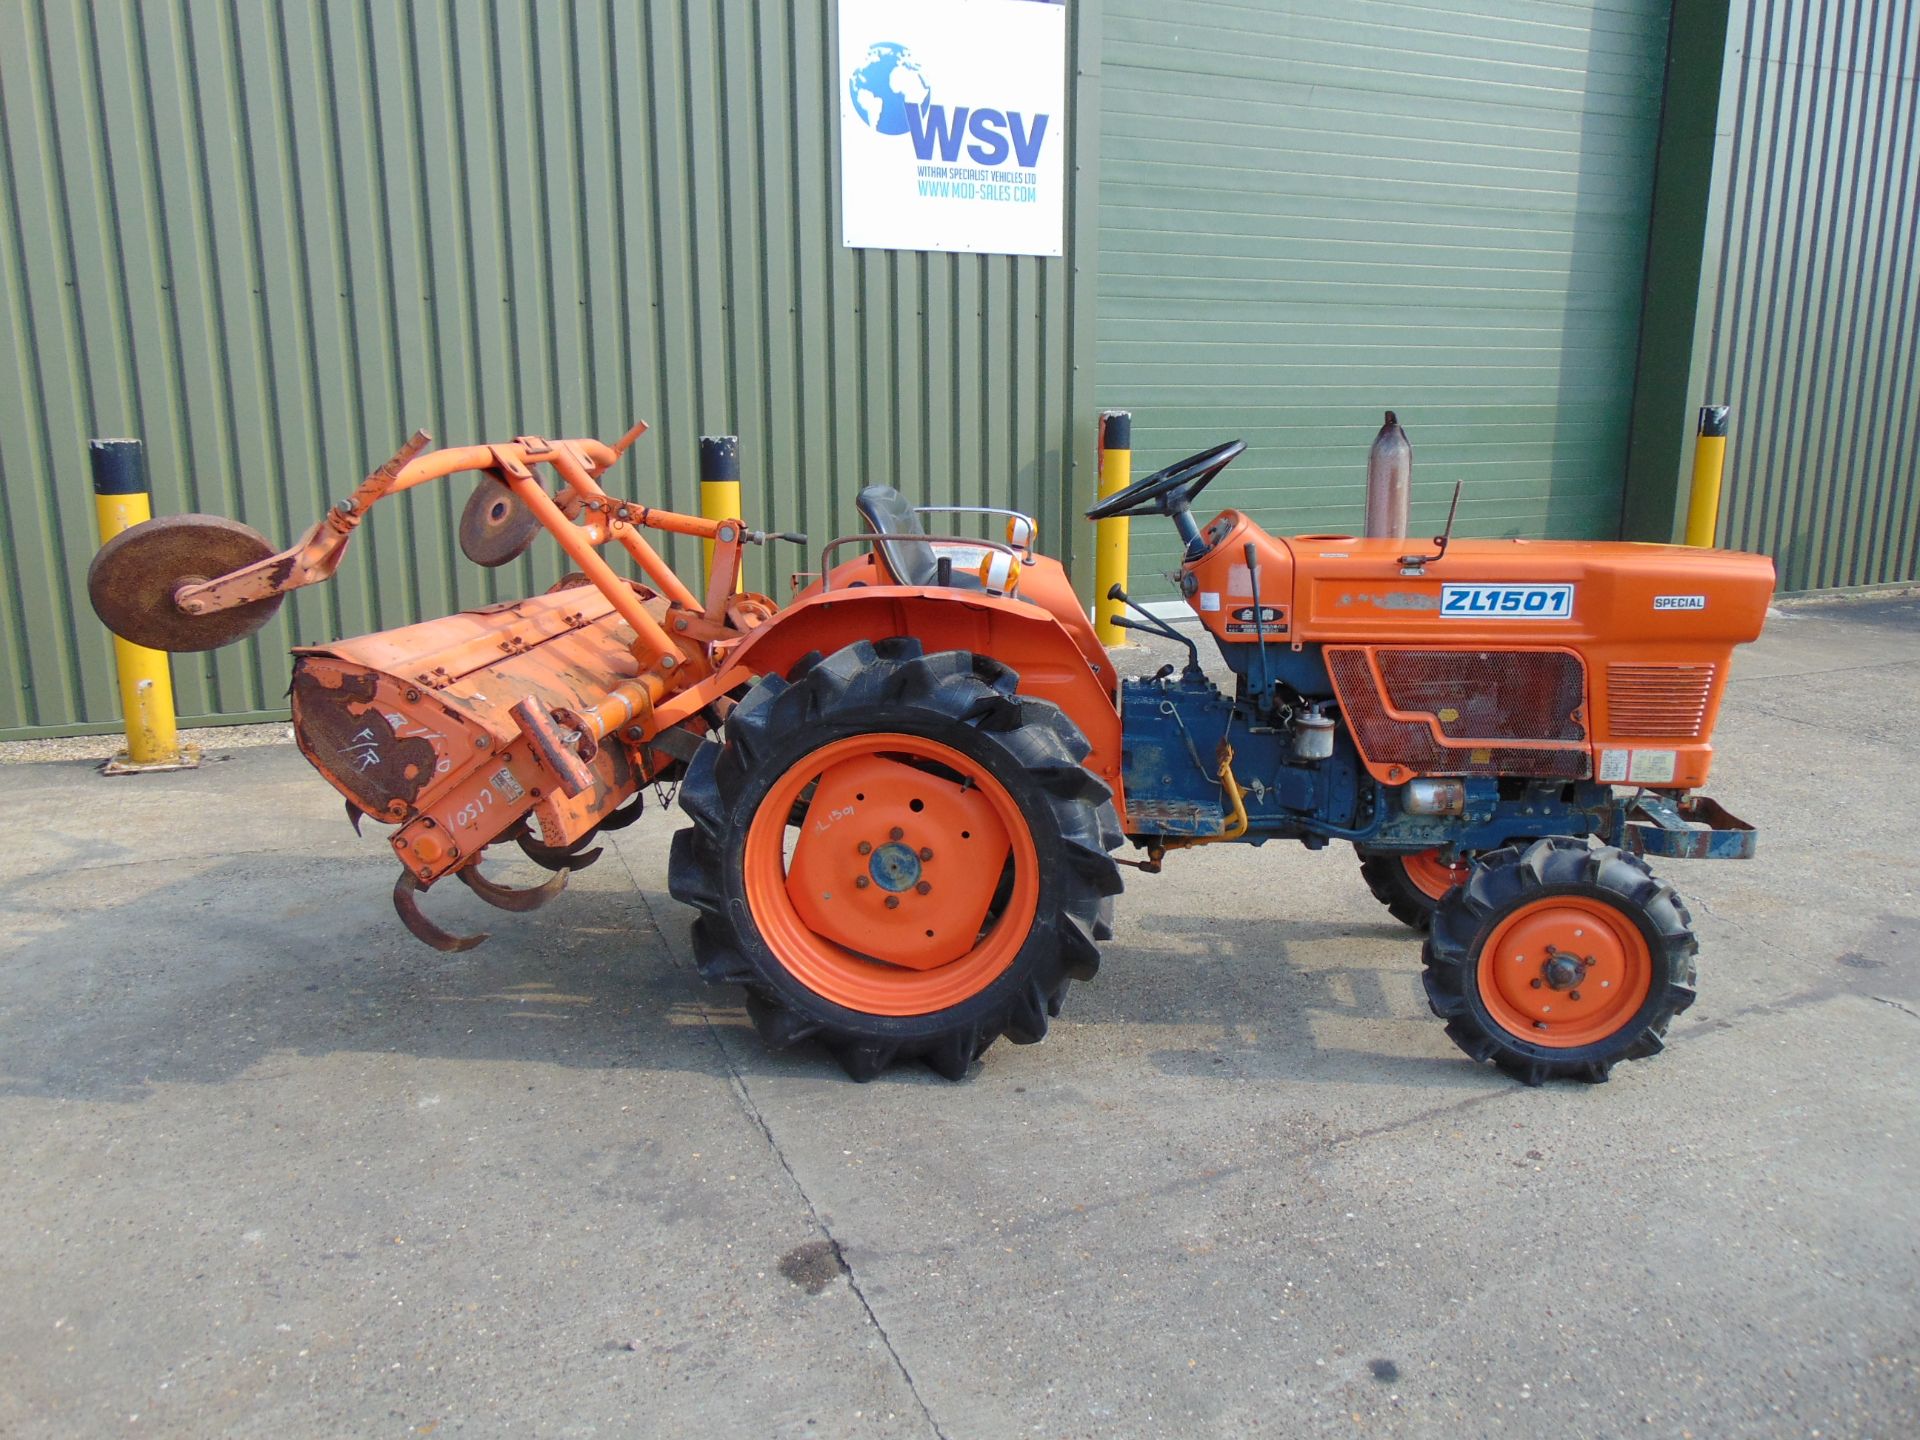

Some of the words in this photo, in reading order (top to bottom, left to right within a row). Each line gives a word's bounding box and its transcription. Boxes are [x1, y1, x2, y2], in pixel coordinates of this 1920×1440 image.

[904, 102, 1049, 167] WSV
[917, 165, 948, 179] WITHAM
[949, 167, 989, 182] SPECIALIST
[990, 170, 1023, 184] VEHICLES
[1024, 172, 1037, 185] LTD
[918, 180, 1036, 202] WWWMOD-SALESCOM
[1445, 591, 1566, 611] ZL1501
[1655, 597, 1704, 609] SPECIAL
